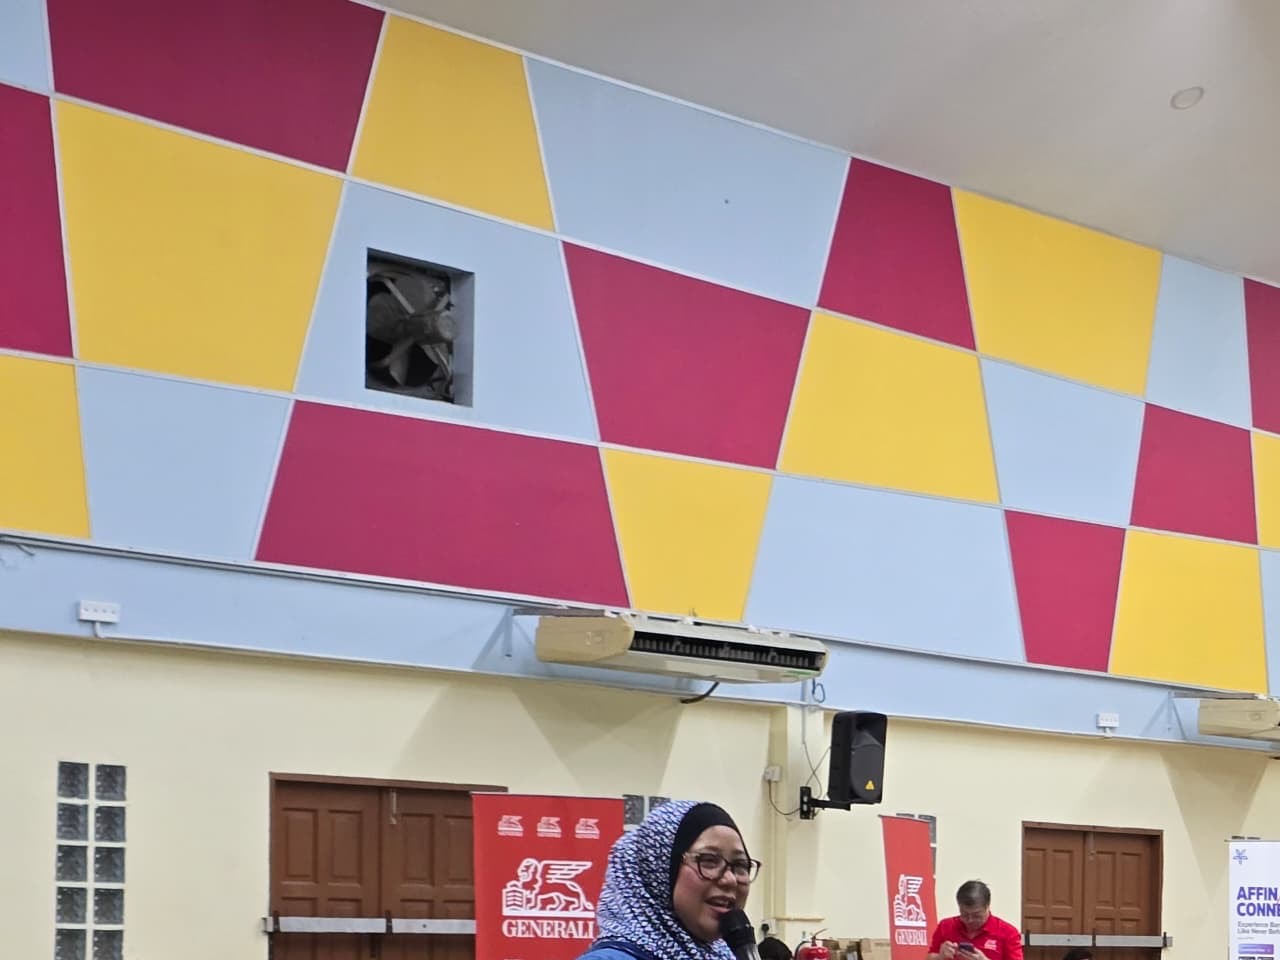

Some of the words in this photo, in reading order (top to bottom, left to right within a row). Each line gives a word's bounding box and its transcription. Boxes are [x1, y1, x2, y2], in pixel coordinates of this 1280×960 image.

[1237, 886, 1278, 901] AFFIN
[502, 919, 595, 939] GENERALI
[1237, 921, 1268, 929] Experience
